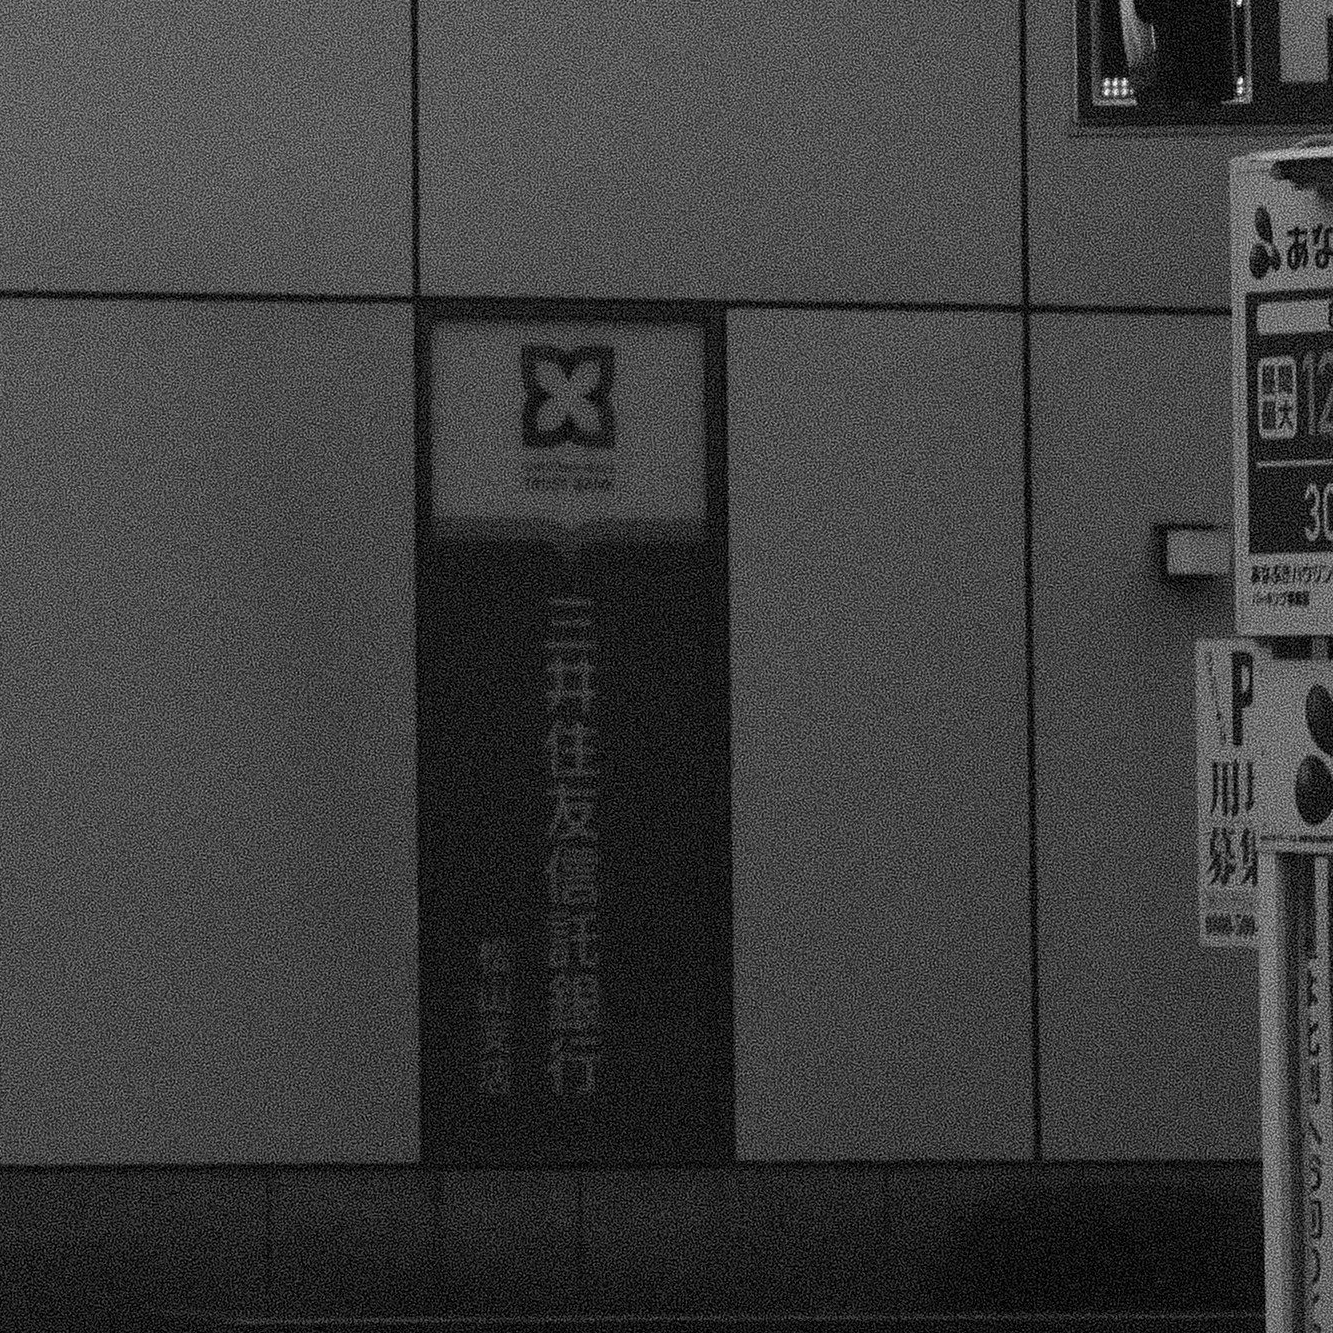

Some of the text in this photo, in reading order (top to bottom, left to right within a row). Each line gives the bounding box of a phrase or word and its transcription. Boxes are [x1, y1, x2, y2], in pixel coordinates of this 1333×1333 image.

[544, 596, 602, 1096] 三井住友信託銀行
[477, 937, 512, 1096] 松山支店
